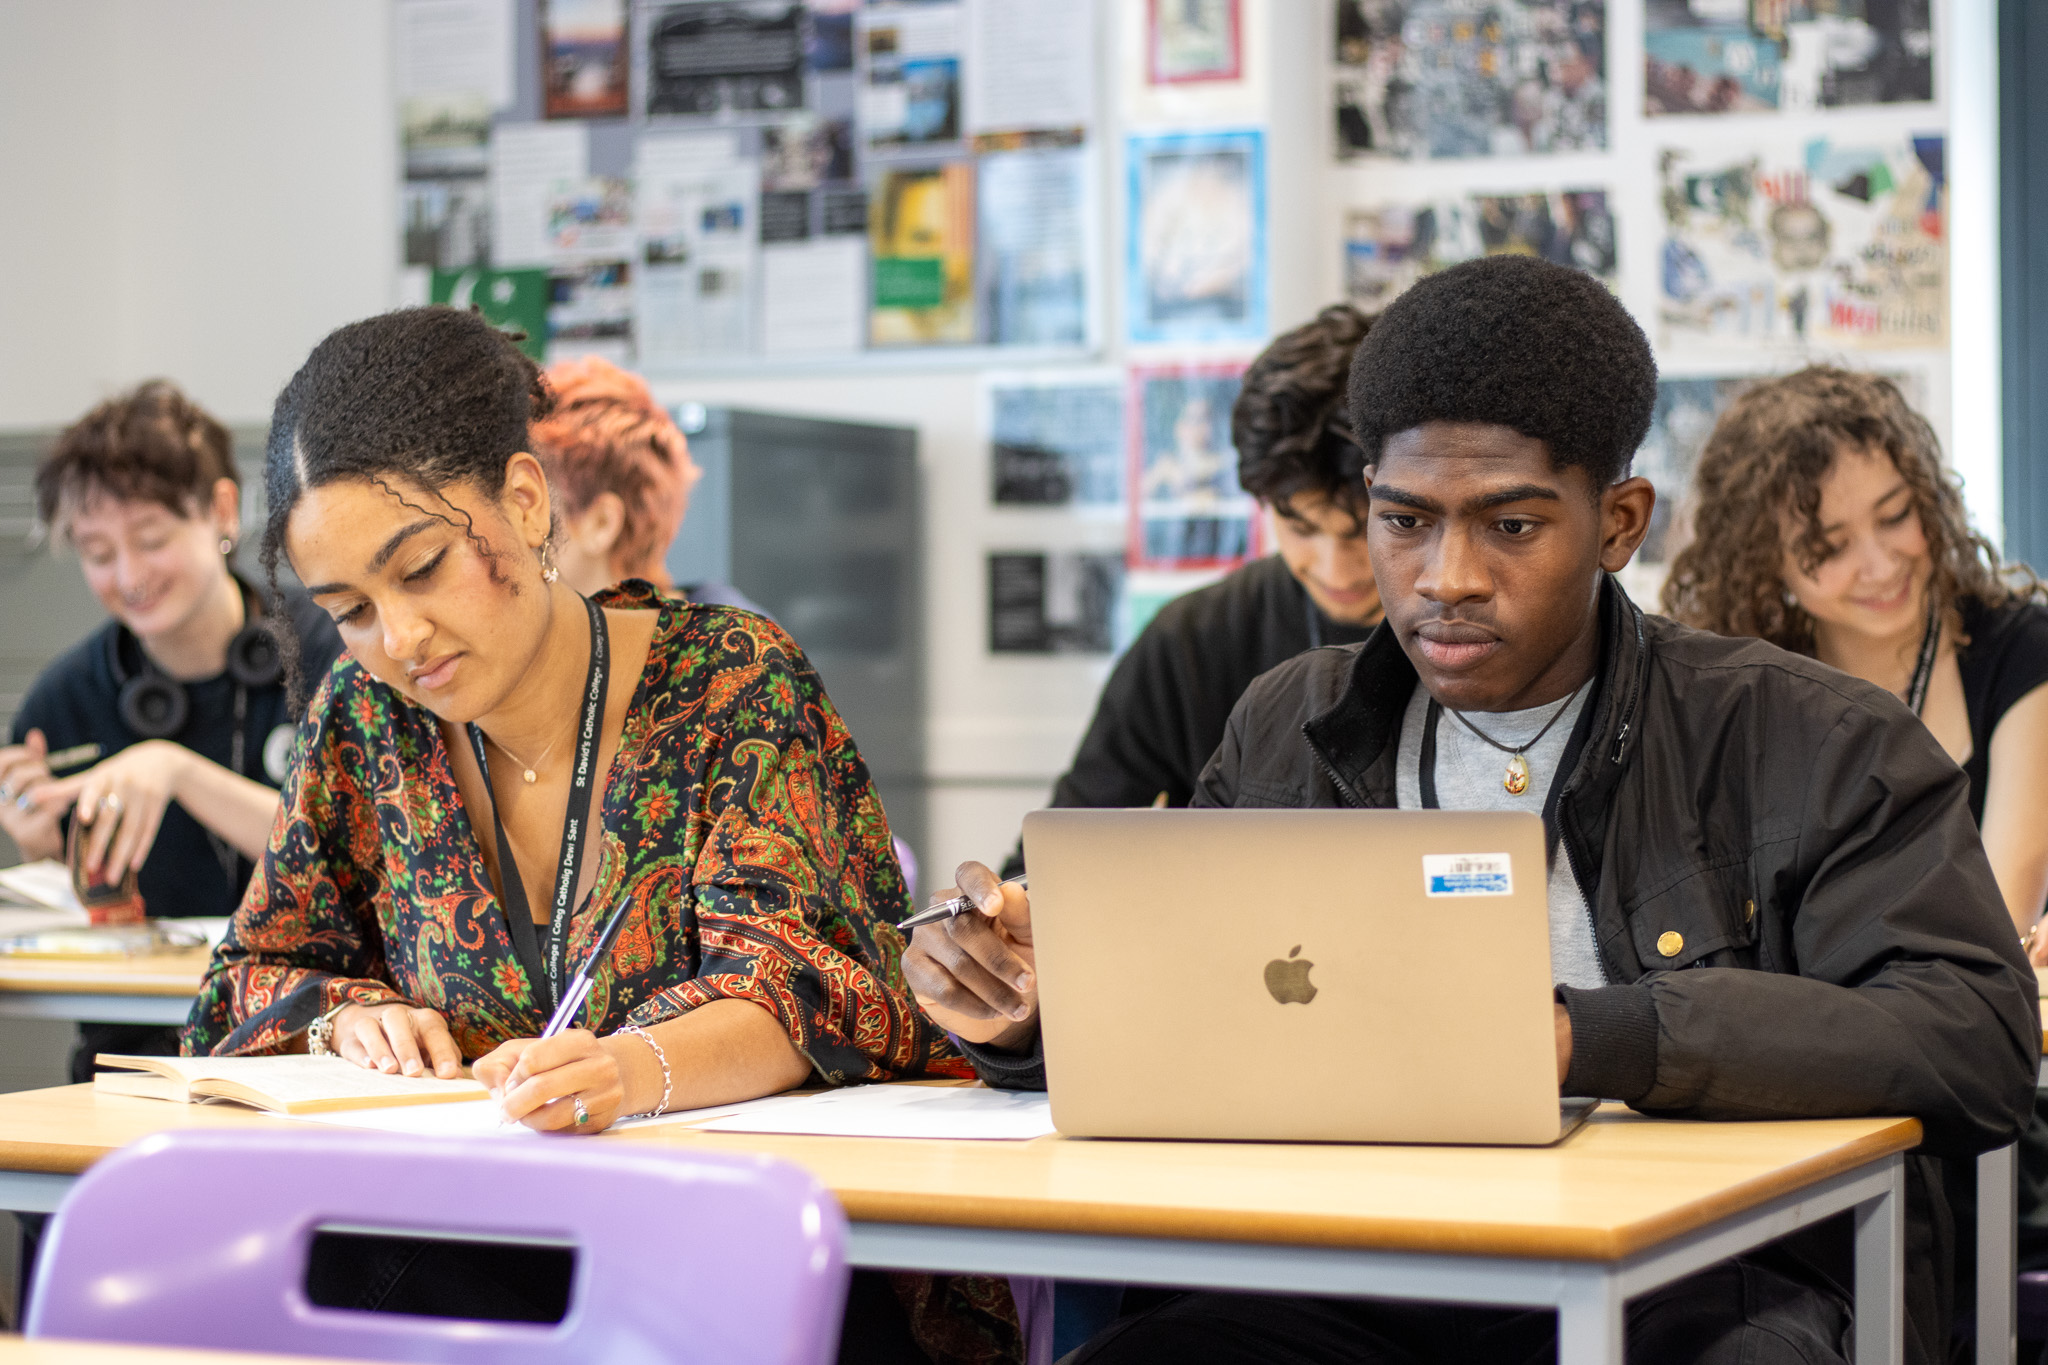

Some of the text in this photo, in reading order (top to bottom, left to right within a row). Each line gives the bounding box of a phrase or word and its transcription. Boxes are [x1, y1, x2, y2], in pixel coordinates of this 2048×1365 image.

[589, 667, 603, 701] College
[583, 702, 598, 739] Catholic
[577, 741, 591, 775] David's
[576, 776, 586, 788] St
[567, 818, 579, 841] Sant
[564, 843, 576, 867] Dewi
[556, 868, 573, 907] Catholig
[552, 909, 566, 935] Coleg
[550, 944, 560, 979] College
[551, 981, 560, 1013] atholic
